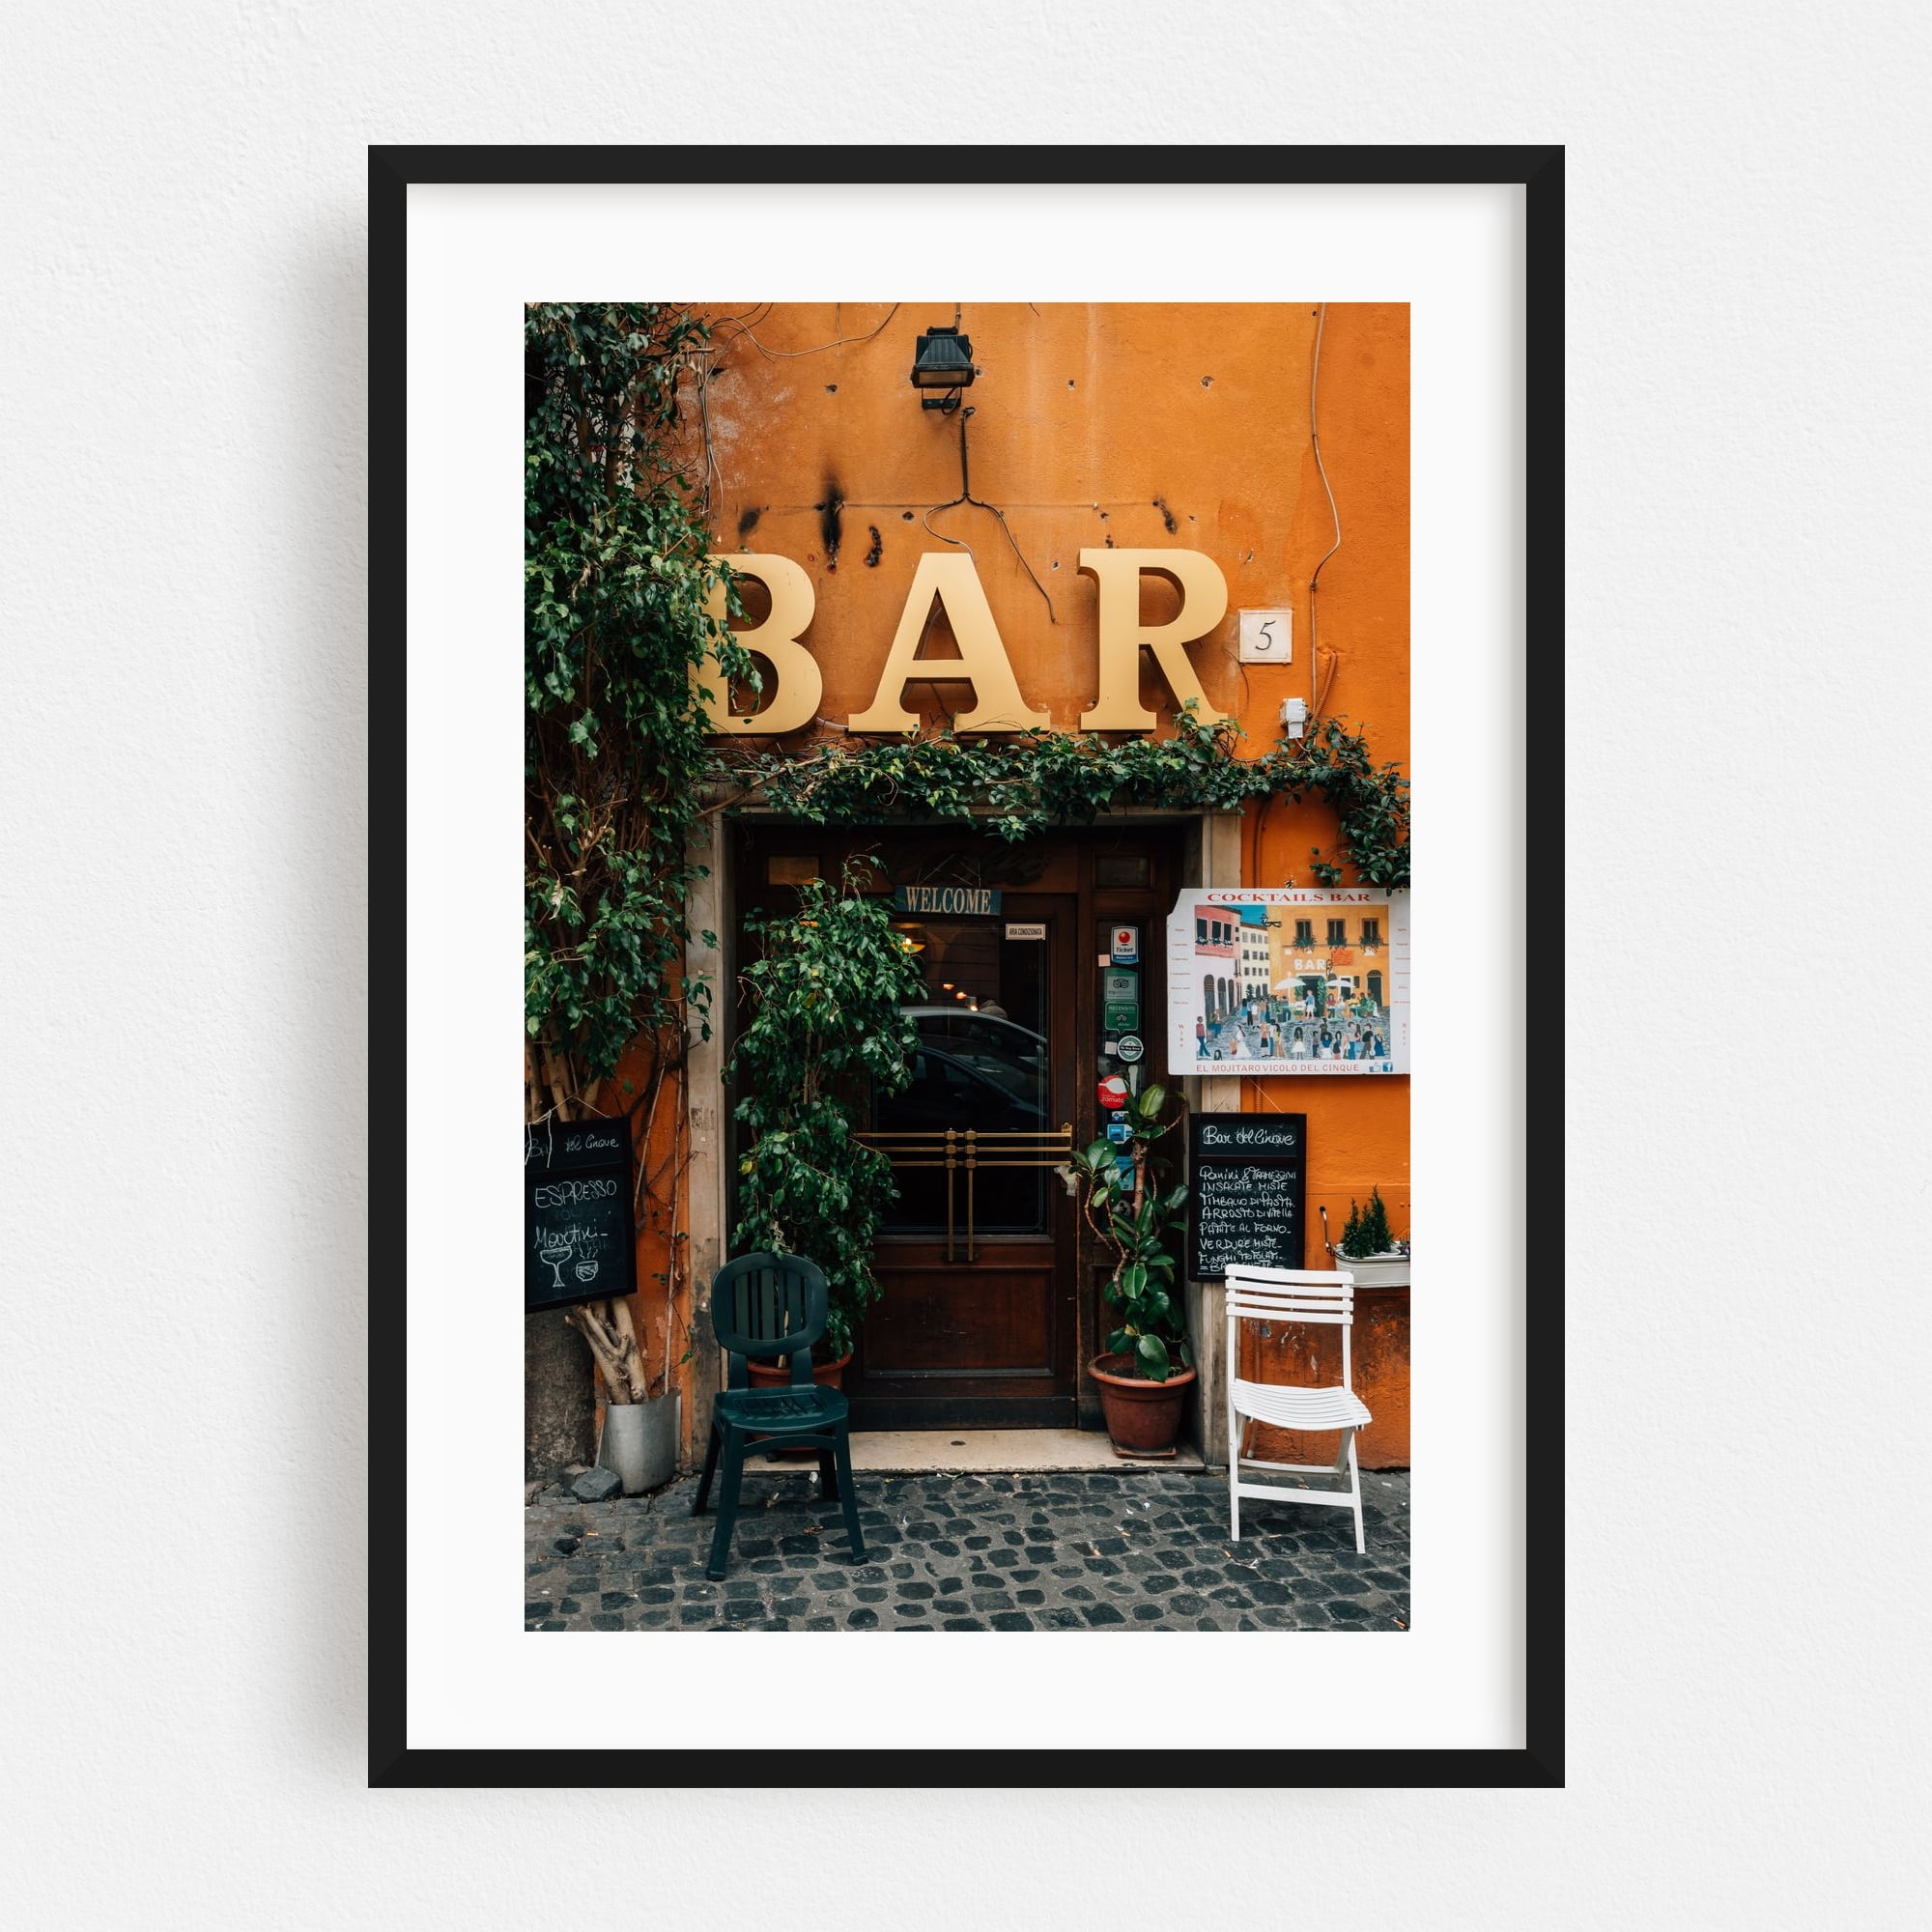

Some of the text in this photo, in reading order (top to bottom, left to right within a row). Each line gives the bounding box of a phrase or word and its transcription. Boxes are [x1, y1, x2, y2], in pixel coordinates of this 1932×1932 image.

[689, 548, 1230, 734] BAR
[1256, 619, 1274, 651] 5
[906, 886, 991, 915] WELCOME
[1208, 893, 1371, 902] COCKTAILS BAR
[1294, 958, 1326, 970] BAR
[1321, 1064, 1360, 1072] CINQUE
[1204, 1125, 1233, 1145] Bar
[1236, 1126, 1254, 1145] del
[1199, 1165, 1239, 1180] Panini
[1258, 1179, 1289, 1191] MISTE
[535, 1179, 617, 1208] ESPRESSO
[1250, 1197, 1260, 1206] DI
[1202, 1206, 1256, 1219] ARROSTO
[1256, 1209, 1265, 1218] DI
[1238, 1223, 1251, 1233] AL
[1200, 1237, 1251, 1250] VERDURE
[1198, 1251, 1236, 1264] FUNGHI
